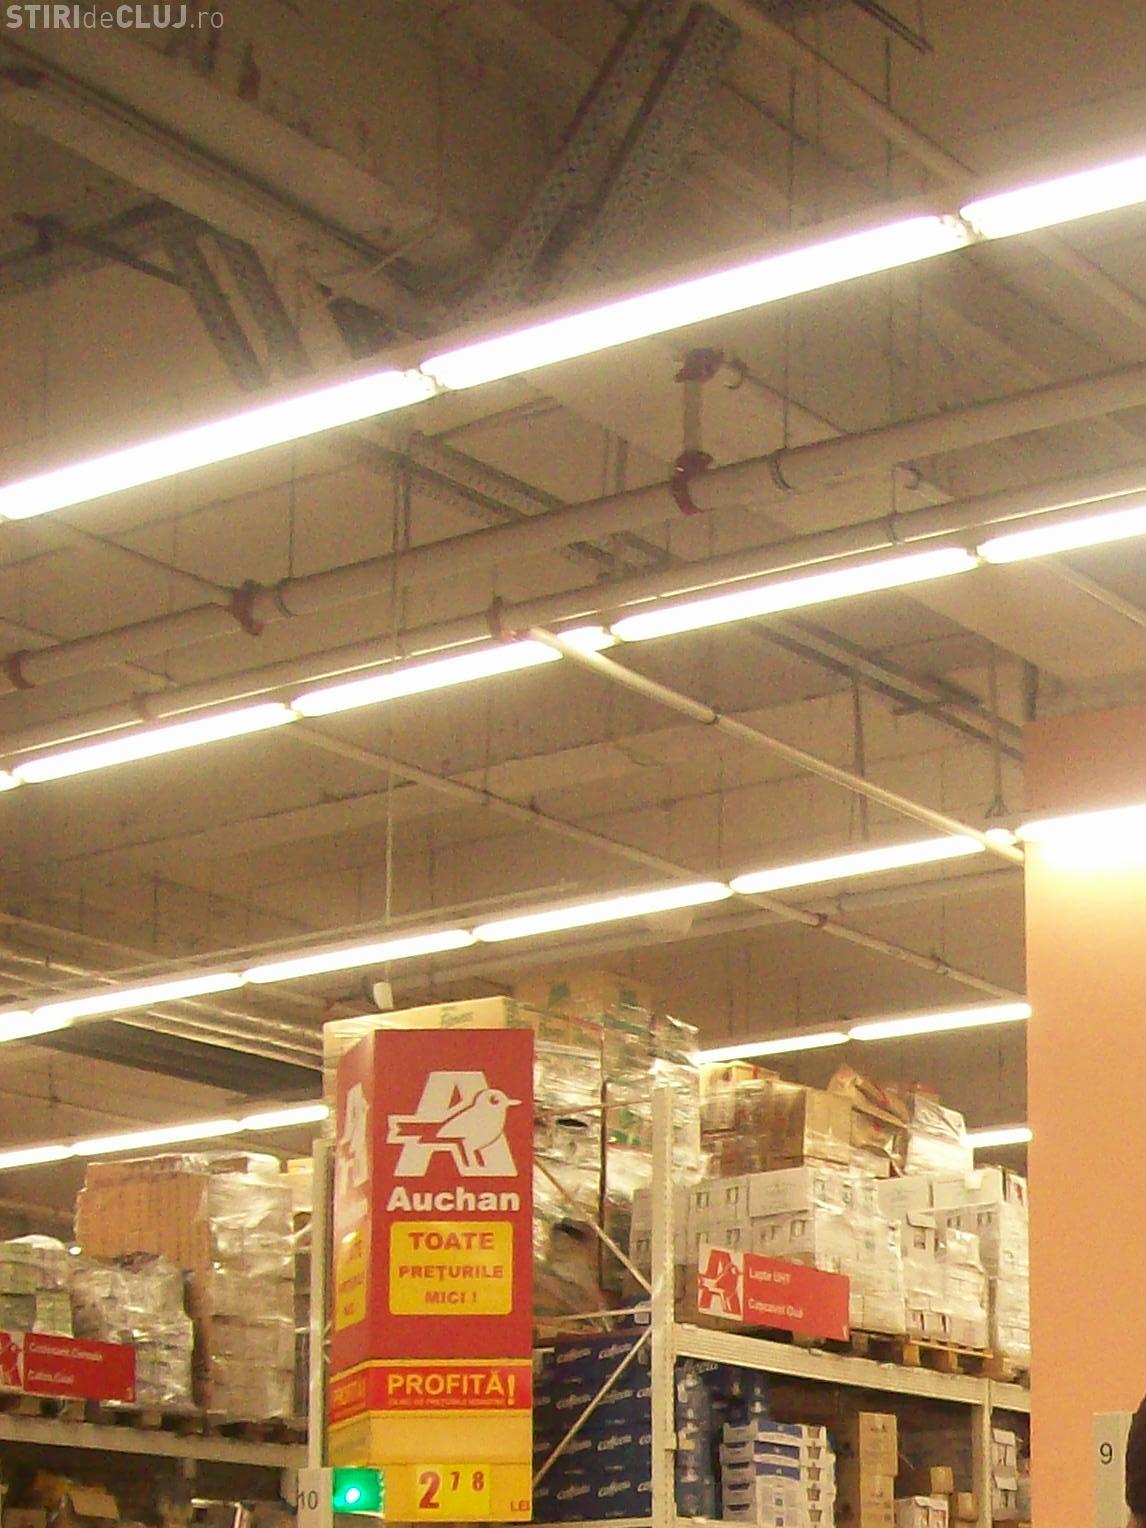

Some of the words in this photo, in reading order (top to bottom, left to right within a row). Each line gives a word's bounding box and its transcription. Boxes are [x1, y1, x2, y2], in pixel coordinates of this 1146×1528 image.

[386, 1186, 520, 1212] Auchan
[408, 1232, 494, 1250] TOATE
[424, 1291, 466, 1304] MICI
[387, 1369, 515, 1406] PROFITĂ!
[1100, 1442, 1113, 1465] 9
[298, 1490, 318, 1511] 10
[418, 1471, 441, 1509] 2
